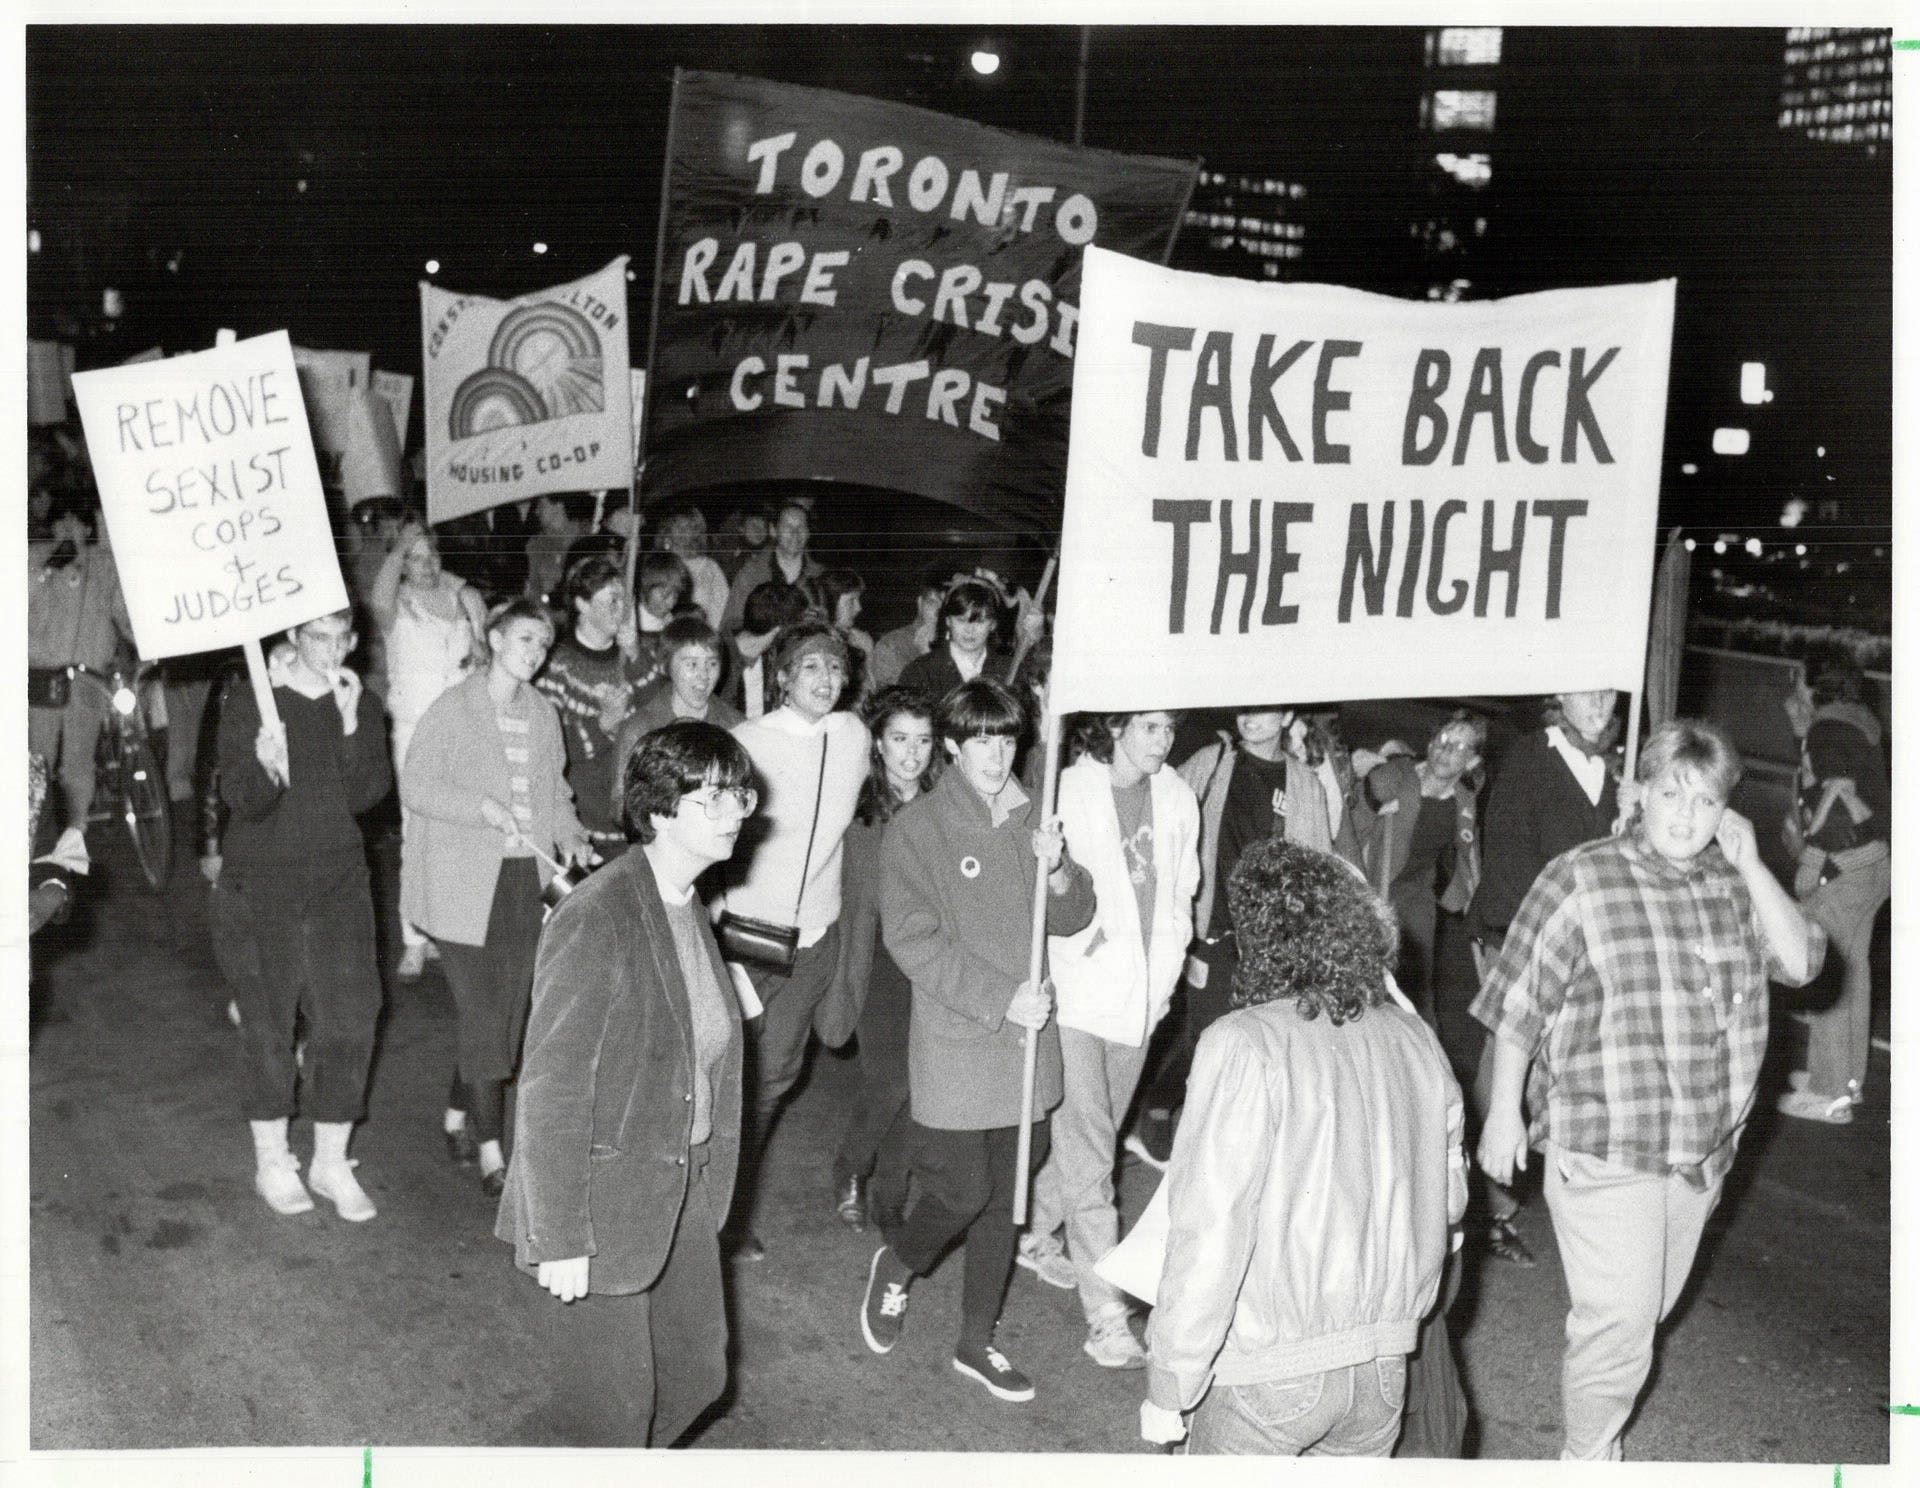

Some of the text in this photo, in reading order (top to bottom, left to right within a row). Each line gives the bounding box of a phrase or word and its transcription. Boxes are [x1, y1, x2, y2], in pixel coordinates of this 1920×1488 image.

[748, 132, 1097, 245] TORONTO
[678, 237, 1080, 358] RAPE CRISI
[117, 371, 288, 453] REMOVE
[730, 354, 1007, 441] CENTRE
[1131, 321, 1622, 467] TAKE BACK
[145, 446, 291, 514] SEXIST
[450, 442, 600, 484] HOUSING CO-OP
[192, 507, 281, 551] COPS
[1152, 499, 1589, 635] THE NIGHT
[164, 565, 303, 624] JUDGES
